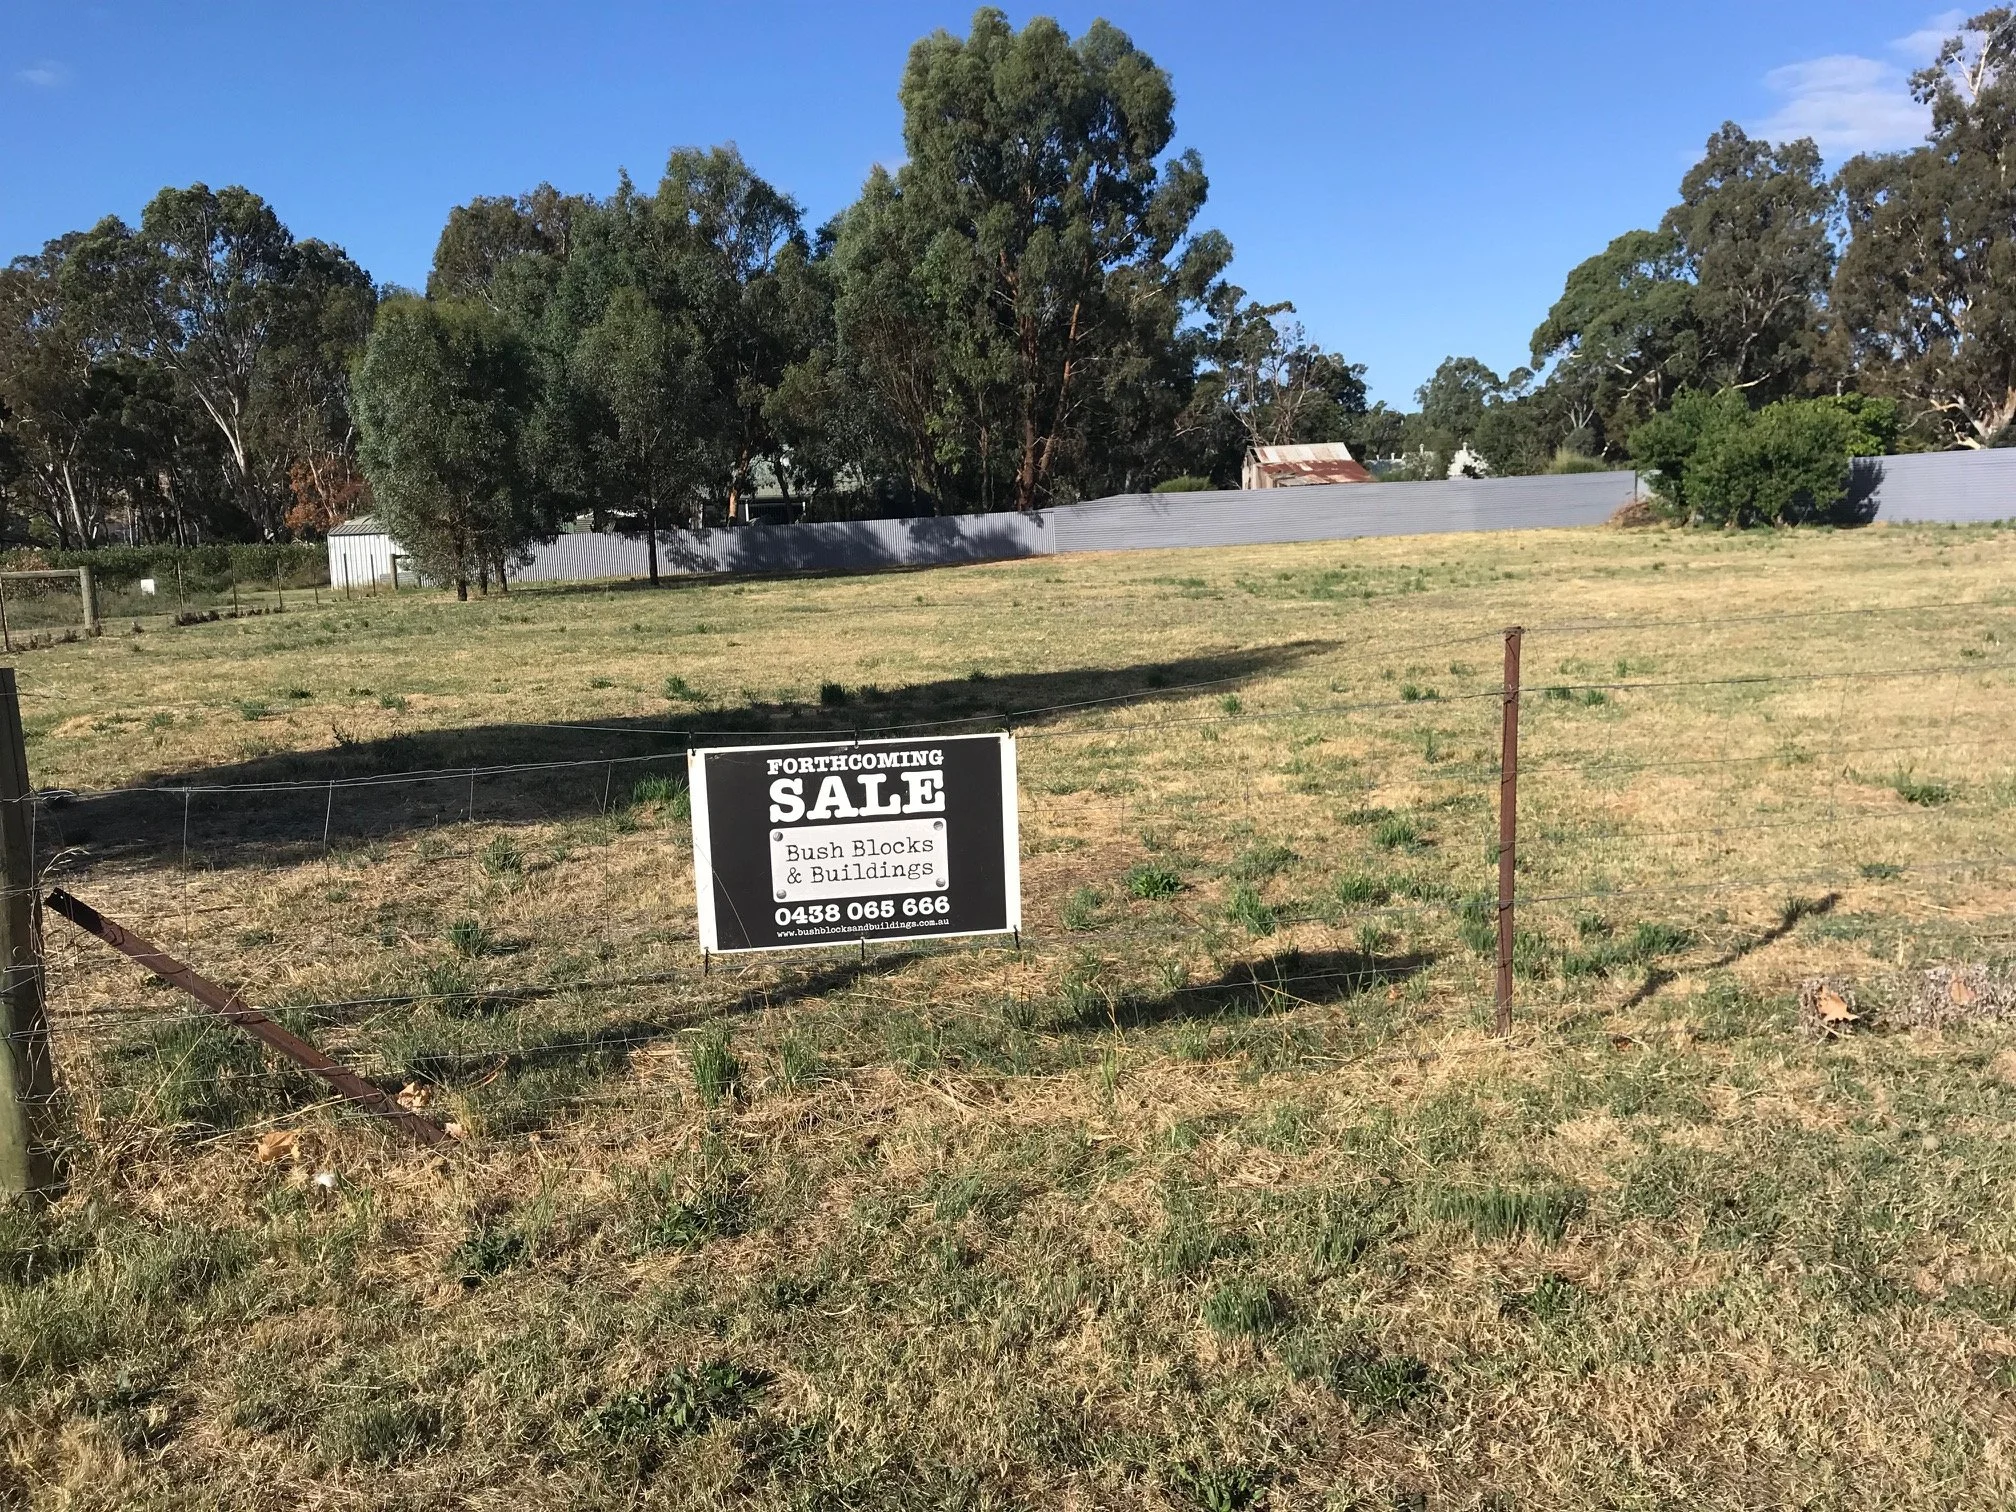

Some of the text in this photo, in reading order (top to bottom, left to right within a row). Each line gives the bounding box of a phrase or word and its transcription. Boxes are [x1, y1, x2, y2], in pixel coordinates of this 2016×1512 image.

[767, 750, 944, 775] FORTHCOMING
[769, 769, 946, 823] SALE
[785, 837, 934, 862] Bush Blocks
[787, 861, 934, 884] & Buildings
[774, 896, 950, 926] 0438 065 666
[776, 918, 950, 938] www.bushblocksandbuildings.com.au
